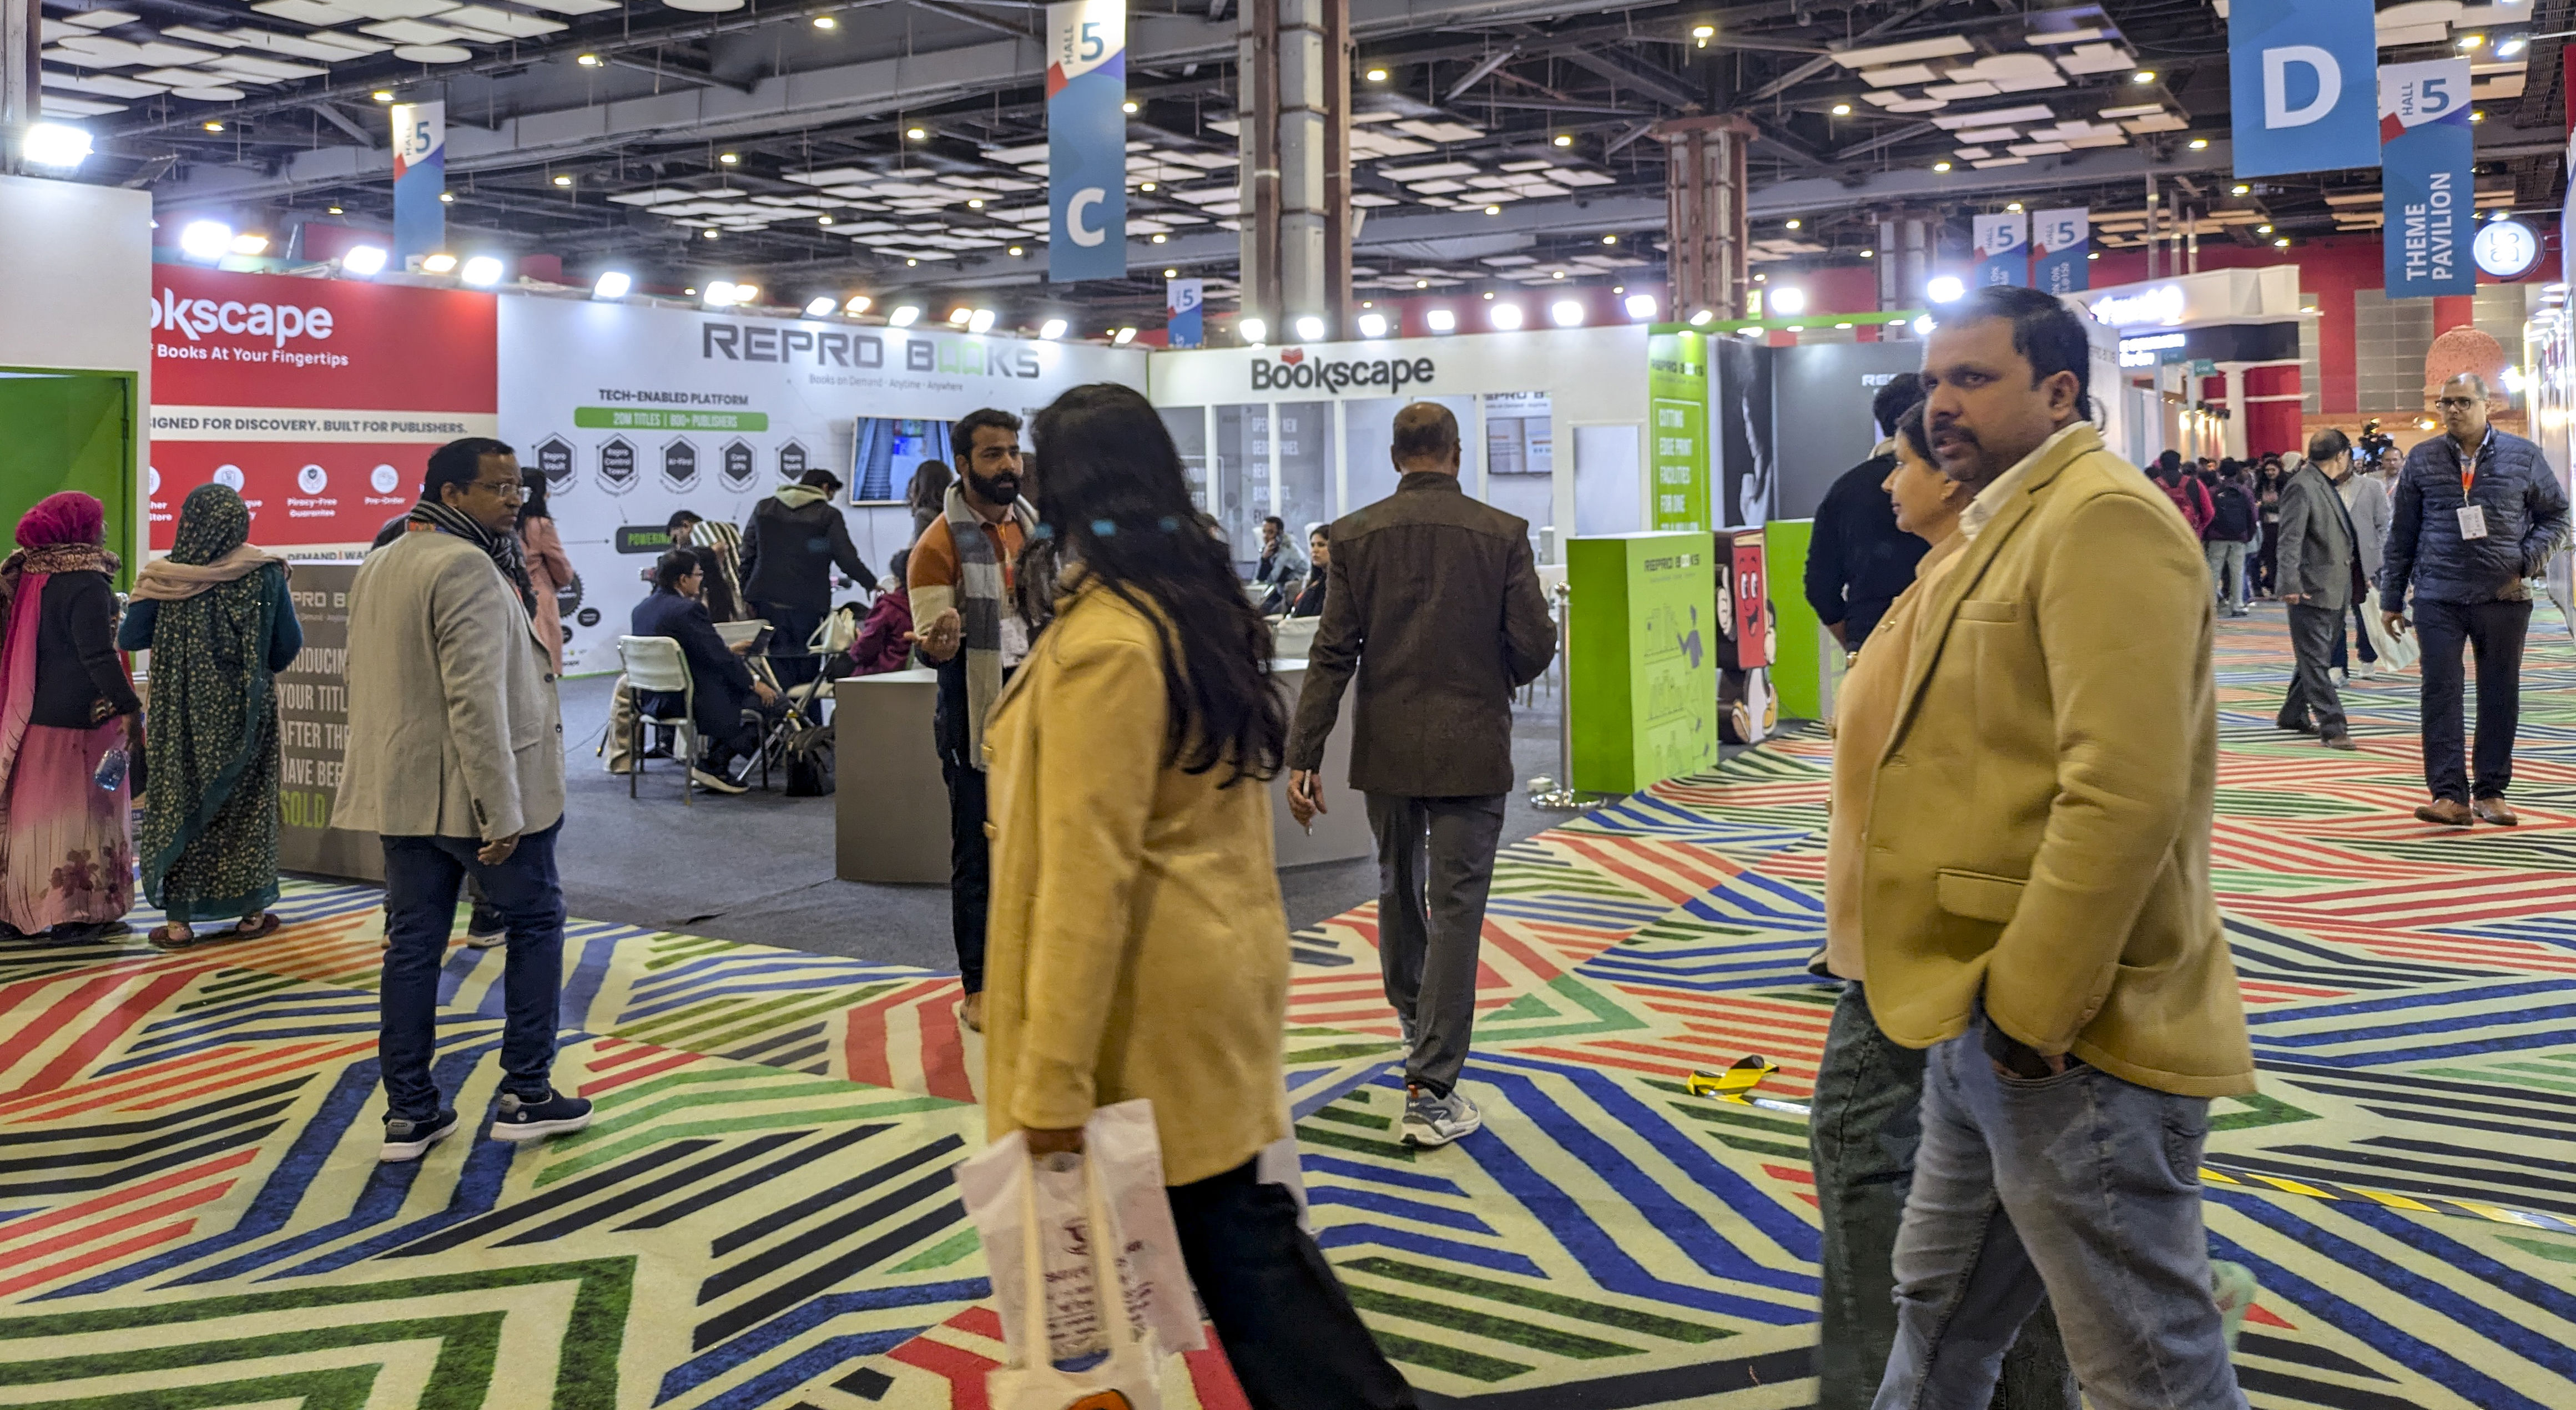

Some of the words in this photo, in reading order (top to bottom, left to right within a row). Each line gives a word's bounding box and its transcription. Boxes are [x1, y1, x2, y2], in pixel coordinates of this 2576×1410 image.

[1065, 24, 1073, 64] HALL
[1081, 22, 1105, 62] 5
[2262, 45, 2342, 130] D
[2402, 82, 2413, 116] HALL
[2422, 78, 2449, 114] 5
[415, 121, 431, 154] 5
[1066, 187, 1106, 247] C
[2058, 221, 2075, 244] 5
[2431, 172, 2453, 281] PAVILION
[1998, 225, 2014, 246] 5
[2406, 203, 2426, 281] THEME
[1183, 289, 1194, 307] 5
[158, 343, 207, 360] Books
[211, 346, 229, 361] At
[233, 347, 269, 362] Your
[271, 348, 350, 368] Fingertips
[703, 322, 884, 369] REPRO
[906, 338, 1040, 379] BOOKS
[809, 373, 834, 385] Books
[849, 376, 883, 388] Demand
[1251, 356, 1435, 394] Bookscape
[599, 388, 689, 404] TECH-ENABLED
[690, 393, 749, 406] PLATFORM
[150, 417, 199, 429] IGNED
[203, 417, 232, 429] FOR
[235, 418, 321, 432] DISCOVERY.
[324, 420, 359, 432] BUILT
[363, 421, 389, 433] FOR
[391, 421, 468, 434] PUBLISHERS.
[634, 413, 661, 427] TITLES
[692, 415, 738, 428] PUBLISHERS
[278, 683, 314, 710] YOUR
[282, 720, 321, 749] AFTER
[280, 790, 326, 828] SOLD
